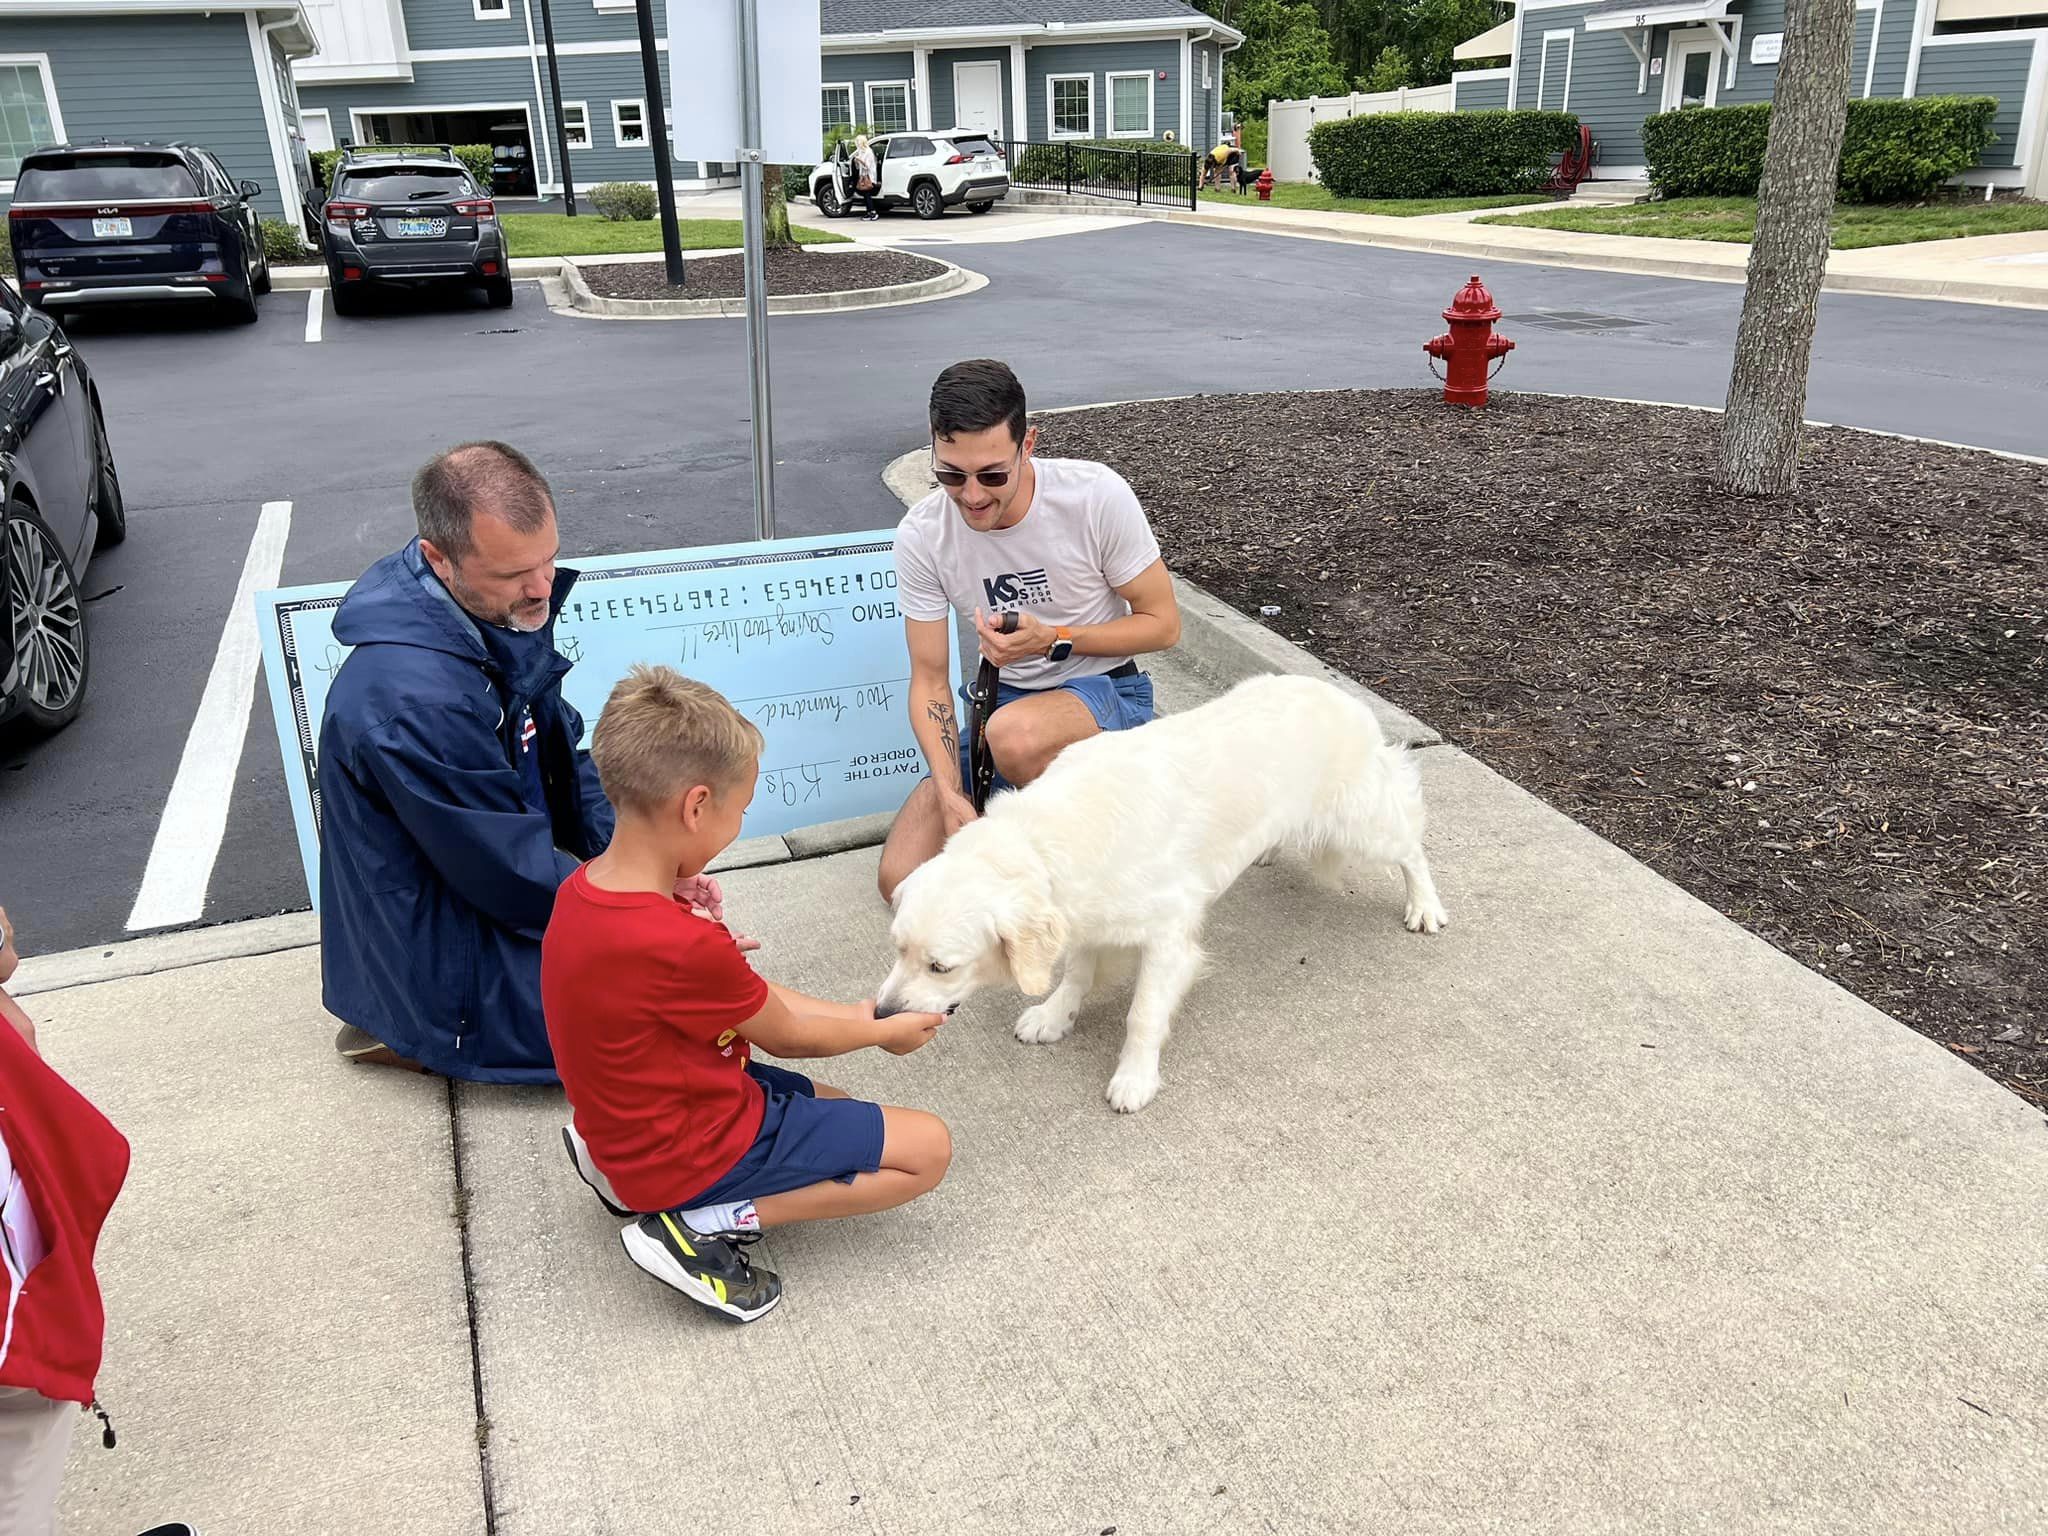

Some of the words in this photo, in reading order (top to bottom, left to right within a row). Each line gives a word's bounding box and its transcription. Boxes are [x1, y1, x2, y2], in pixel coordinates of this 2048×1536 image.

[1635, 14, 1647, 26] 95
[1031, 590, 1051, 598] FOR
[852, 602, 903, 623] EMO
[991, 597, 1053, 612] WARRIORS
[743, 616, 773, 646] two
[776, 603, 834, 646] Saving
[856, 684, 894, 712] two
[755, 695, 848, 727] hundred
[849, 755, 868, 767] OF
[869, 748, 916, 764] ORDER
[843, 769, 870, 782] THE
